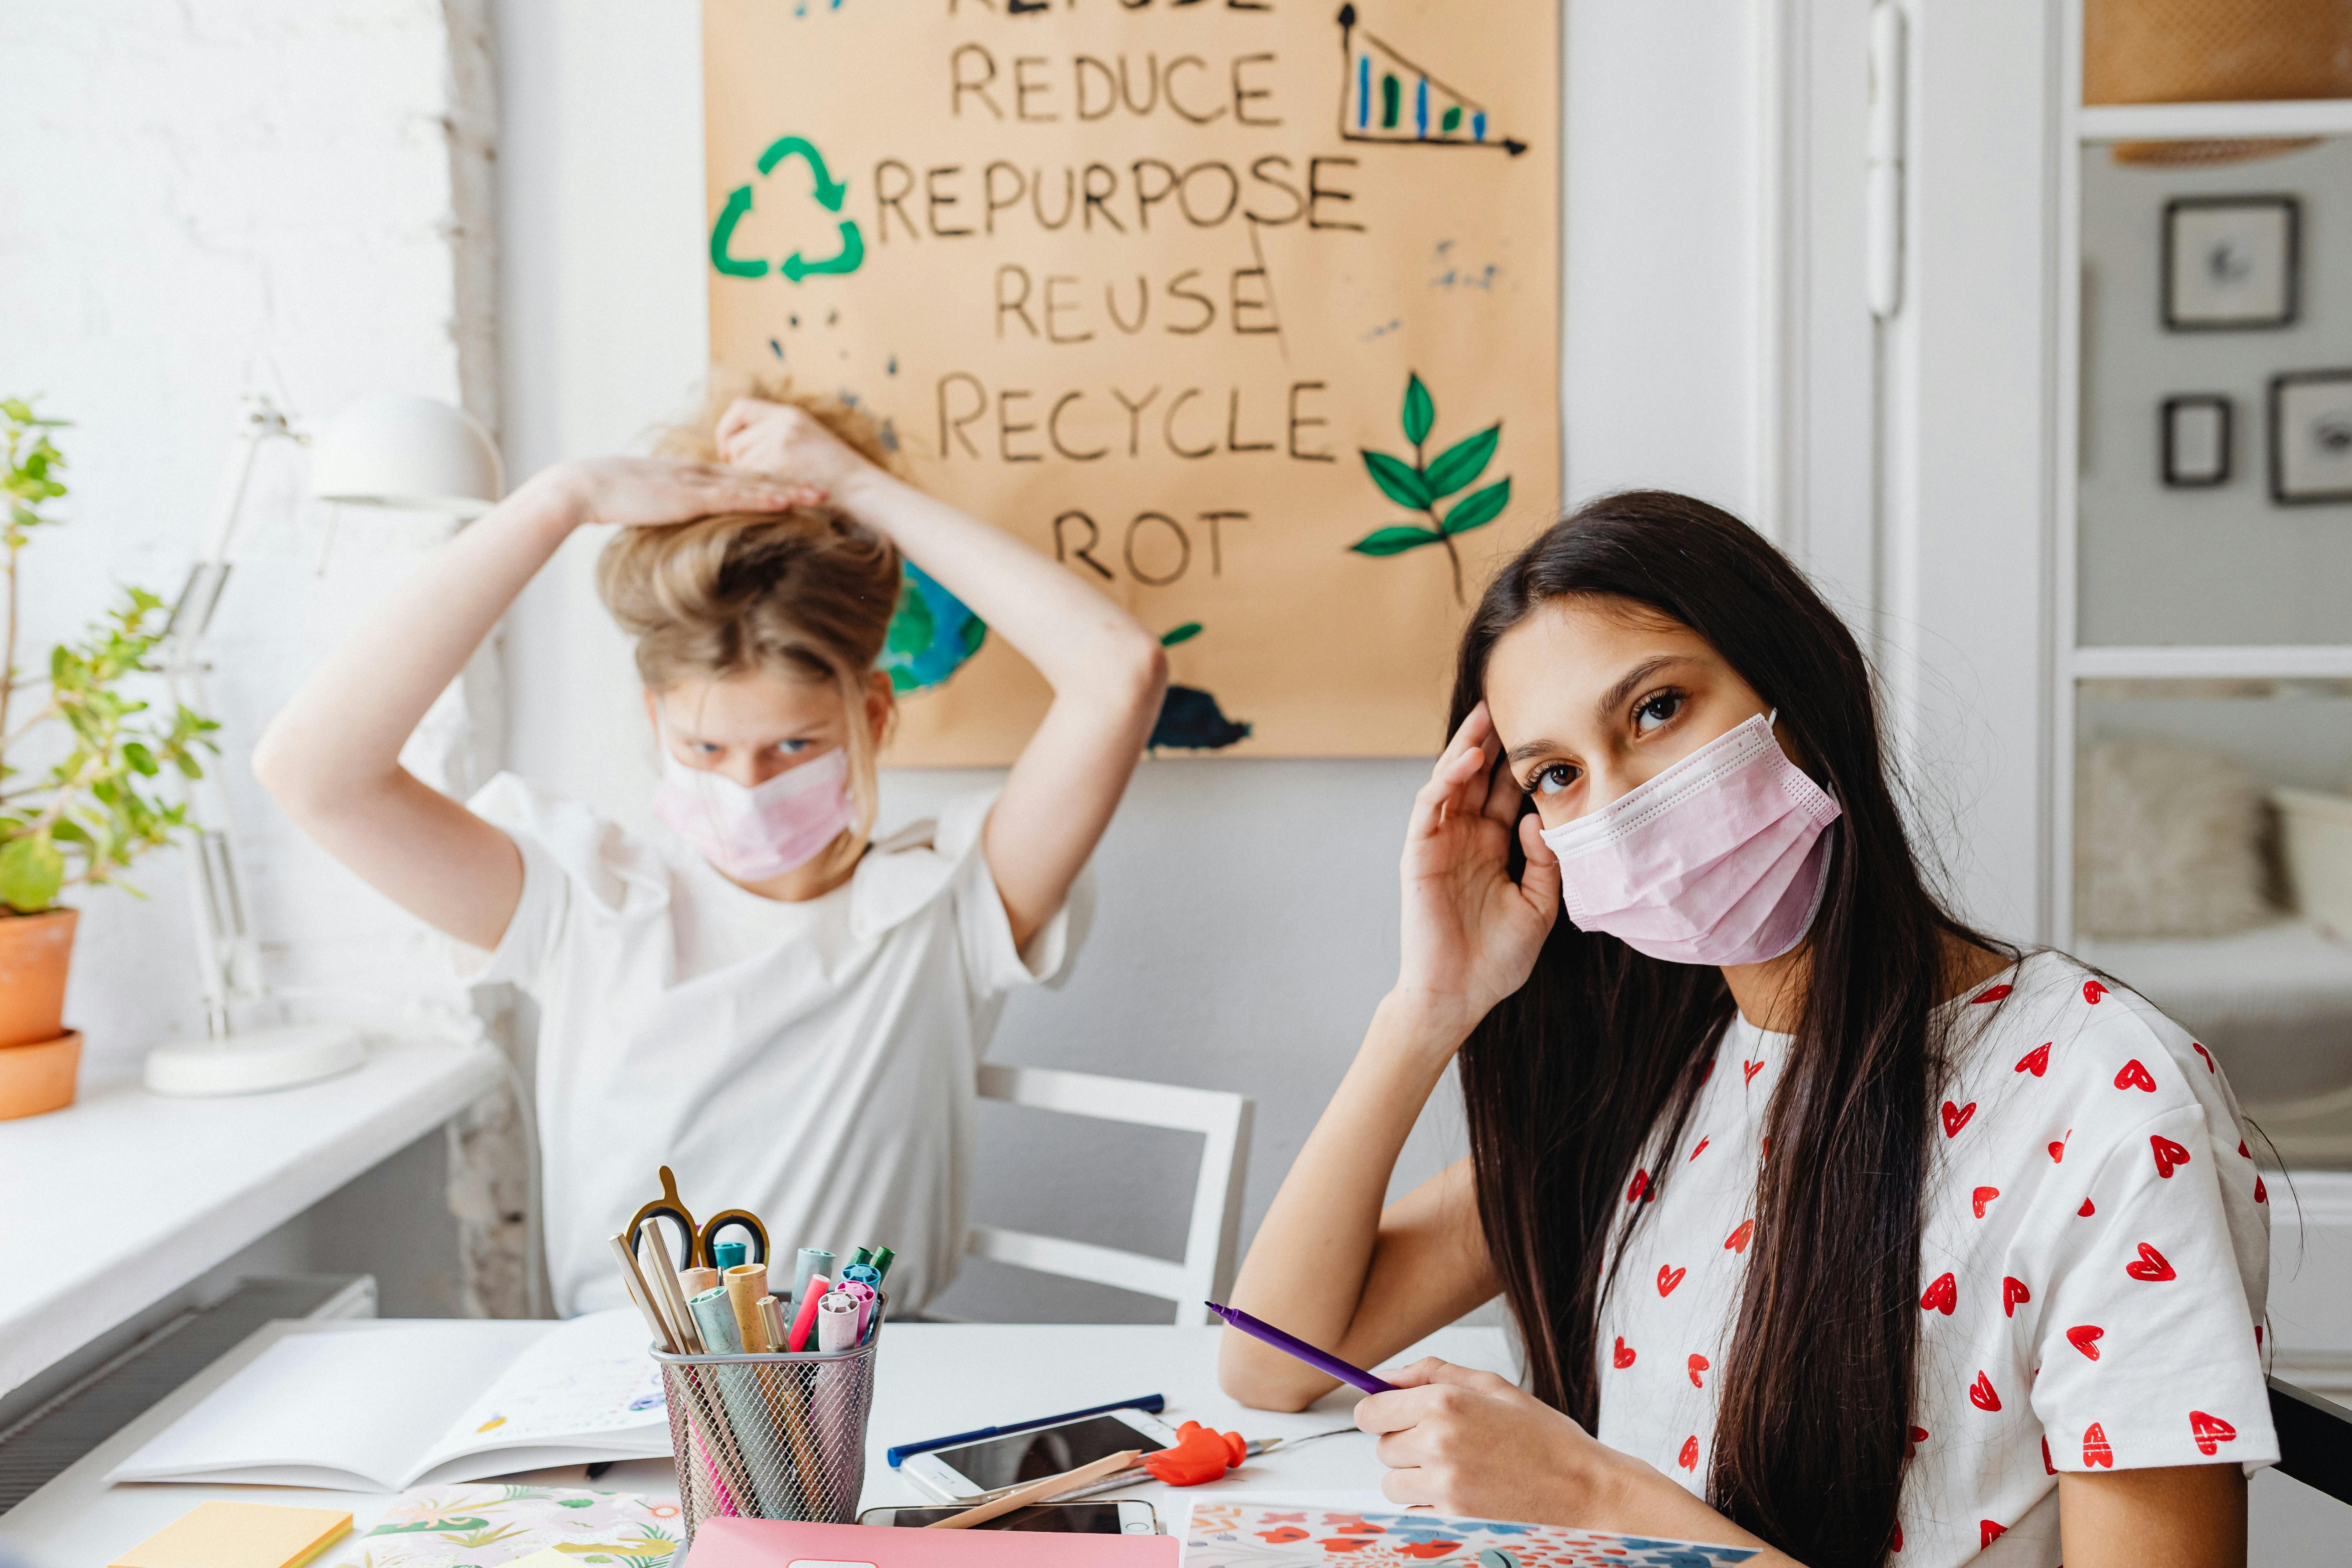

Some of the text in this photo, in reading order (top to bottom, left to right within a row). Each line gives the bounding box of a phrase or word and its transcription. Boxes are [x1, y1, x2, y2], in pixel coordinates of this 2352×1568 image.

[950, 42, 1284, 126] REDUCE
[874, 156, 1367, 244] REPURPOSE
[996, 263, 1280, 344] REUSE
[937, 371, 1337, 463] RECYCLE
[1052, 510, 1250, 587] ROT
